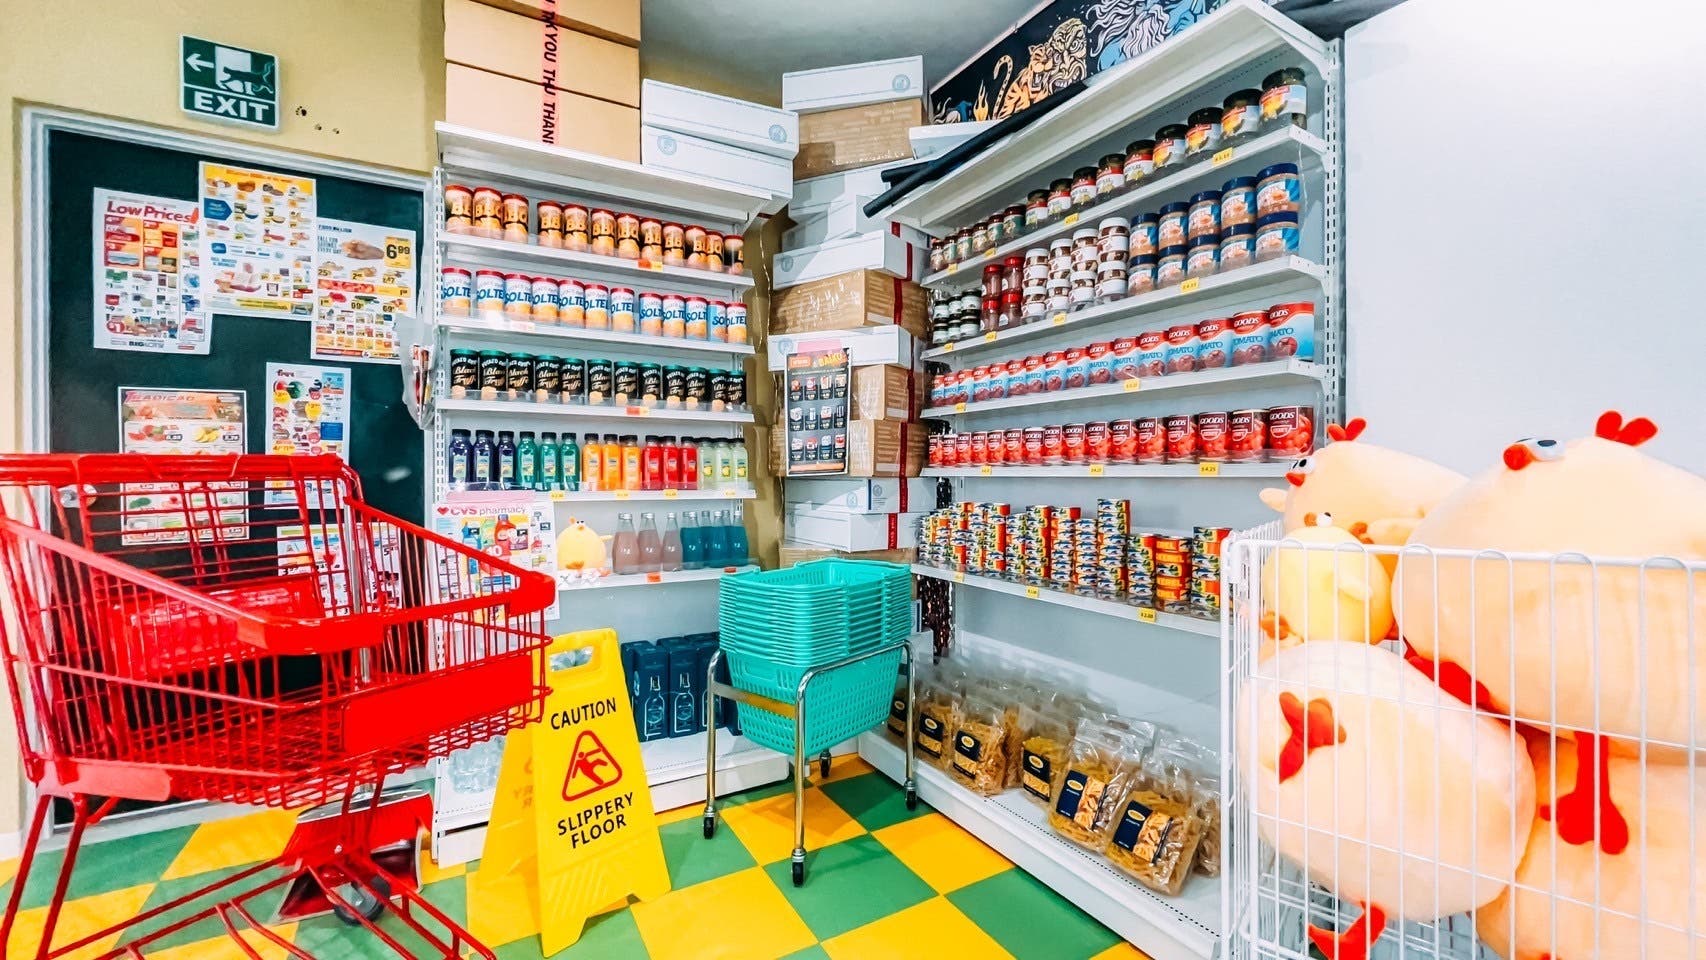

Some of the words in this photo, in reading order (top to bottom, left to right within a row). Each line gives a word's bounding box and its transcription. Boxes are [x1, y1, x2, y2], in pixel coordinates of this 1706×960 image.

[543, 33, 558, 63] YOU
[193, 90, 270, 121] EXIT
[106, 200, 143, 216] Low
[143, 205, 192, 223] Prices
[479, 506, 527, 516] pharmacy
[550, 697, 617, 730] CAUTION
[557, 792, 634, 836] SLIPPERY
[571, 813, 627, 849] FLOOR
